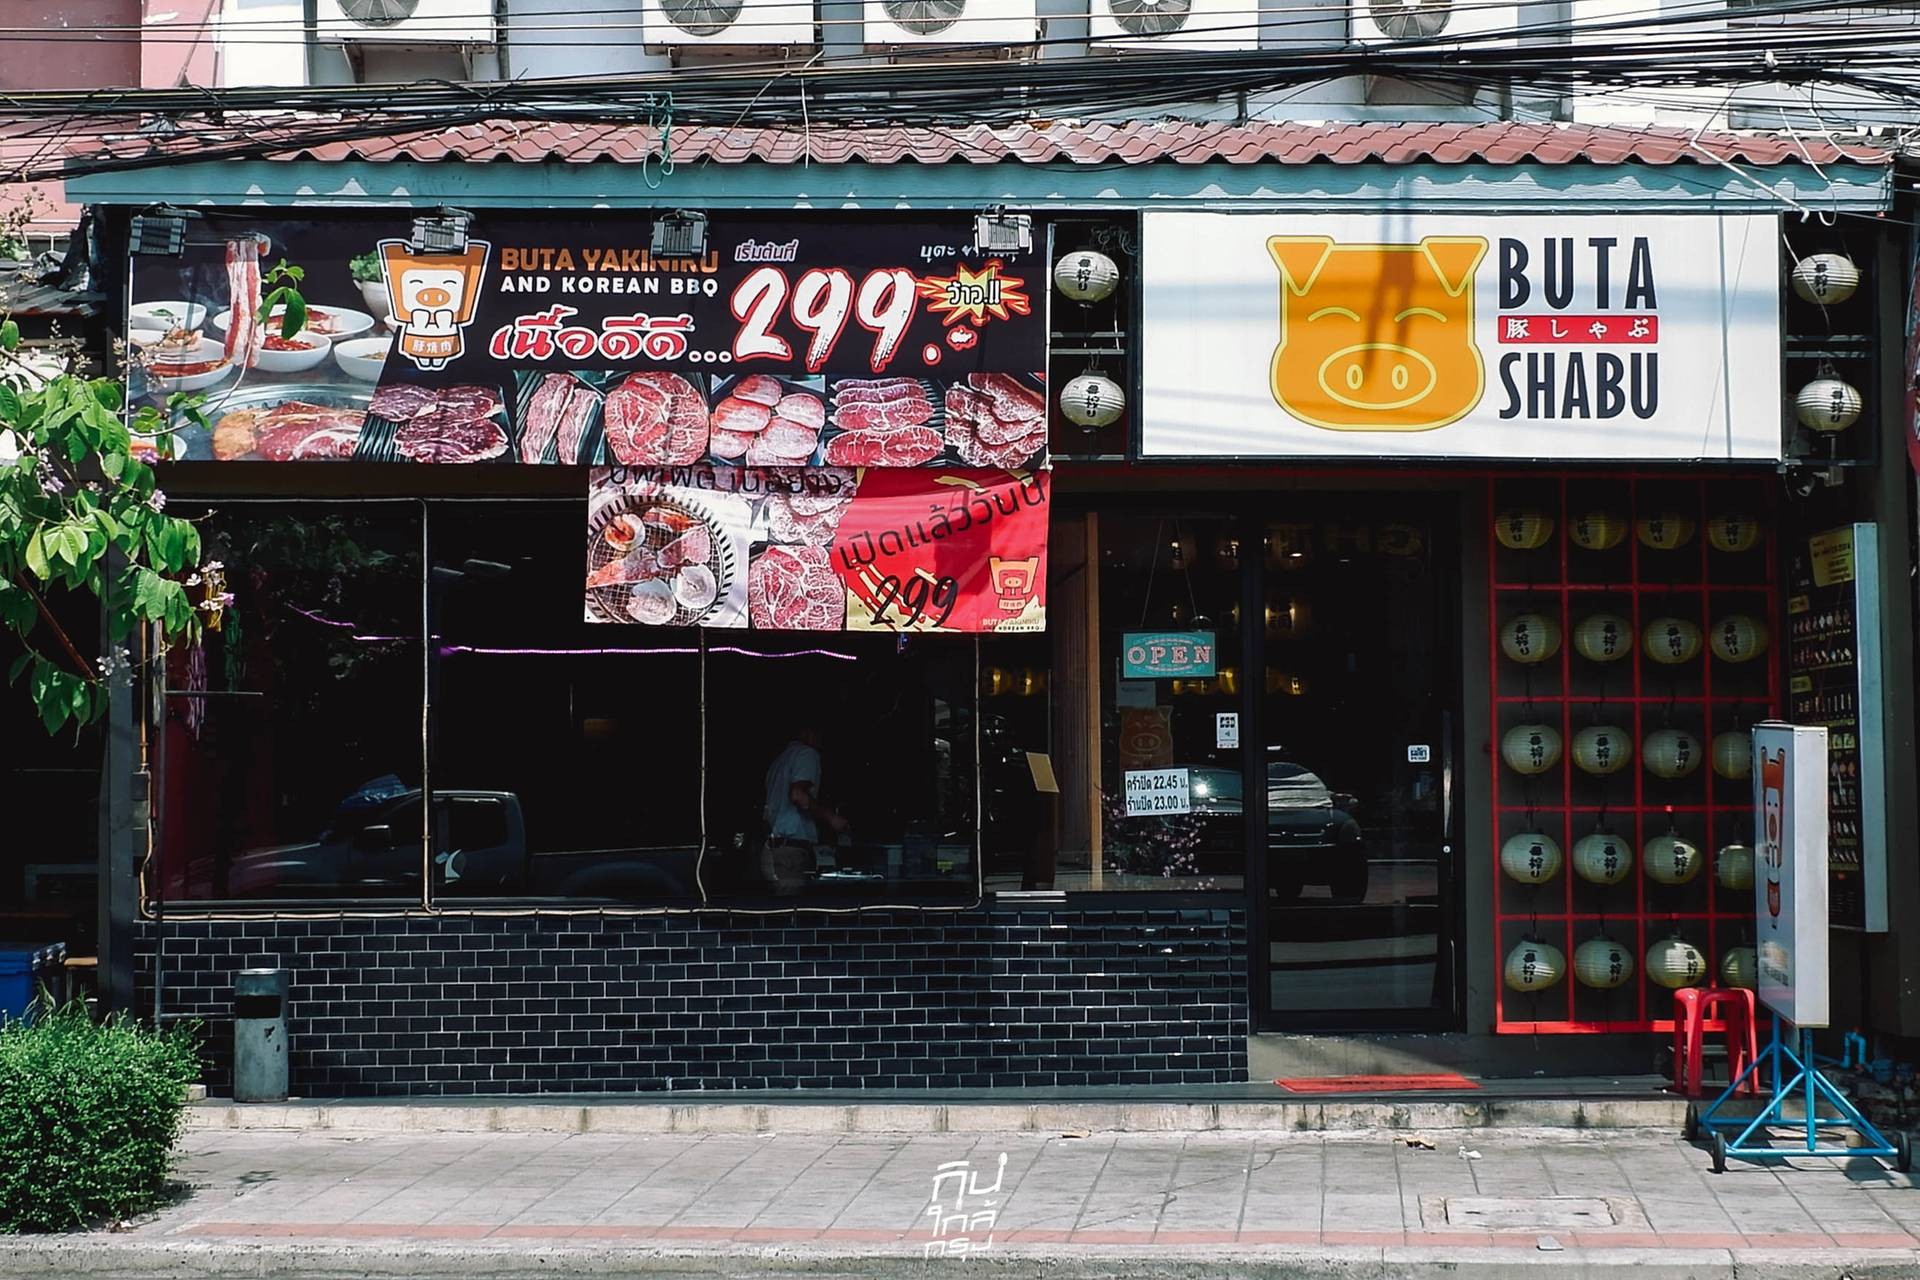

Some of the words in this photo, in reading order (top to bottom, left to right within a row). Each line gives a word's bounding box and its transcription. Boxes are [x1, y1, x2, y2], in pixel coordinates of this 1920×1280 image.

[501, 248, 576, 272] BUTA
[1499, 237, 1657, 310] BUTA
[501, 276, 550, 293] AND
[561, 277, 659, 294] KOREAN
[670, 278, 718, 297] BBQ
[1506, 318, 1650, 339] 豚しゃぶ
[1499, 352, 1658, 419] SHABU
[870, 574, 959, 628] 299
[1127, 645, 1211, 665] OPEN
[1153, 775, 1178, 790] 22.45
[1154, 795, 1178, 810] 23.00
